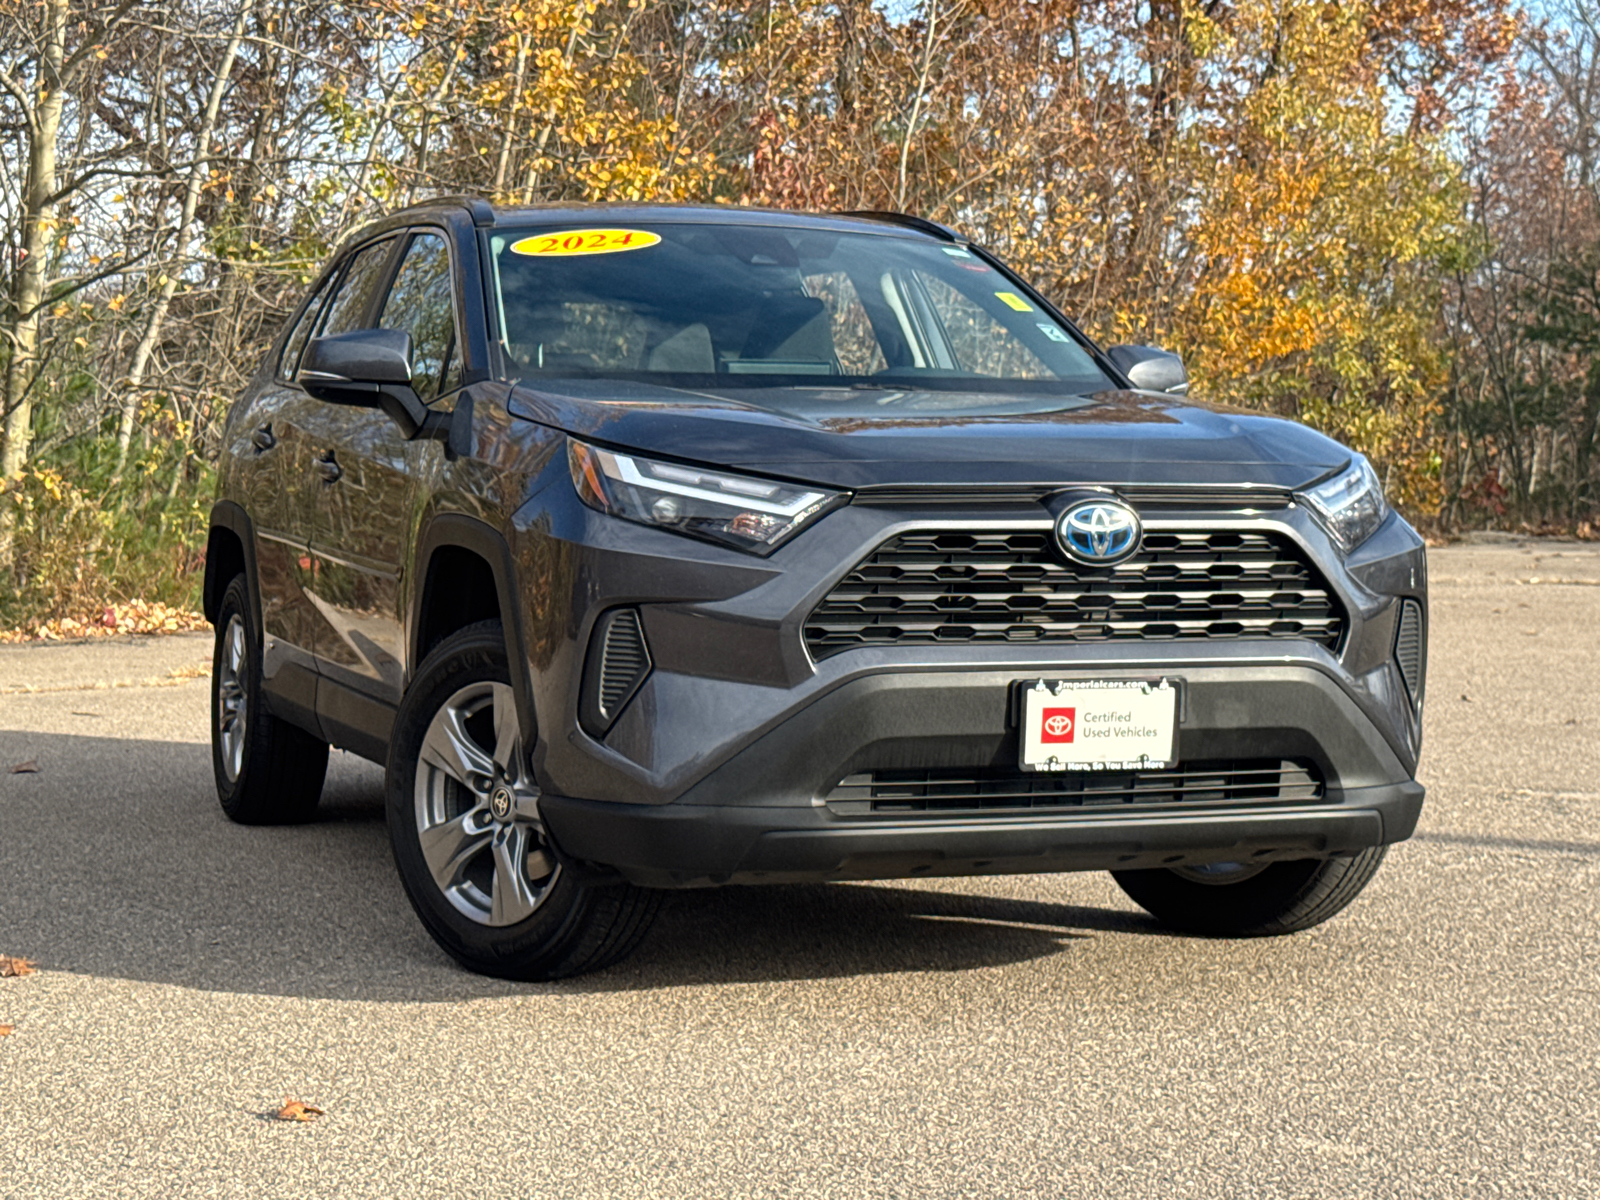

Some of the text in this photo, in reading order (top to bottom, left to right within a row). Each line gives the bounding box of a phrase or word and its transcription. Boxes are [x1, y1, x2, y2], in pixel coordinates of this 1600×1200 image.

[538, 232, 634, 254] 2024
[1083, 711, 1132, 723] Certified
[1083, 726, 1158, 738] Used Vehicles
[1034, 762, 1049, 772] We
[1050, 762, 1065, 771] Sell
[1092, 761, 1104, 771] So
[1104, 761, 1121, 770] You
[1122, 760, 1142, 770] Save
[1143, 760, 1165, 770] More
